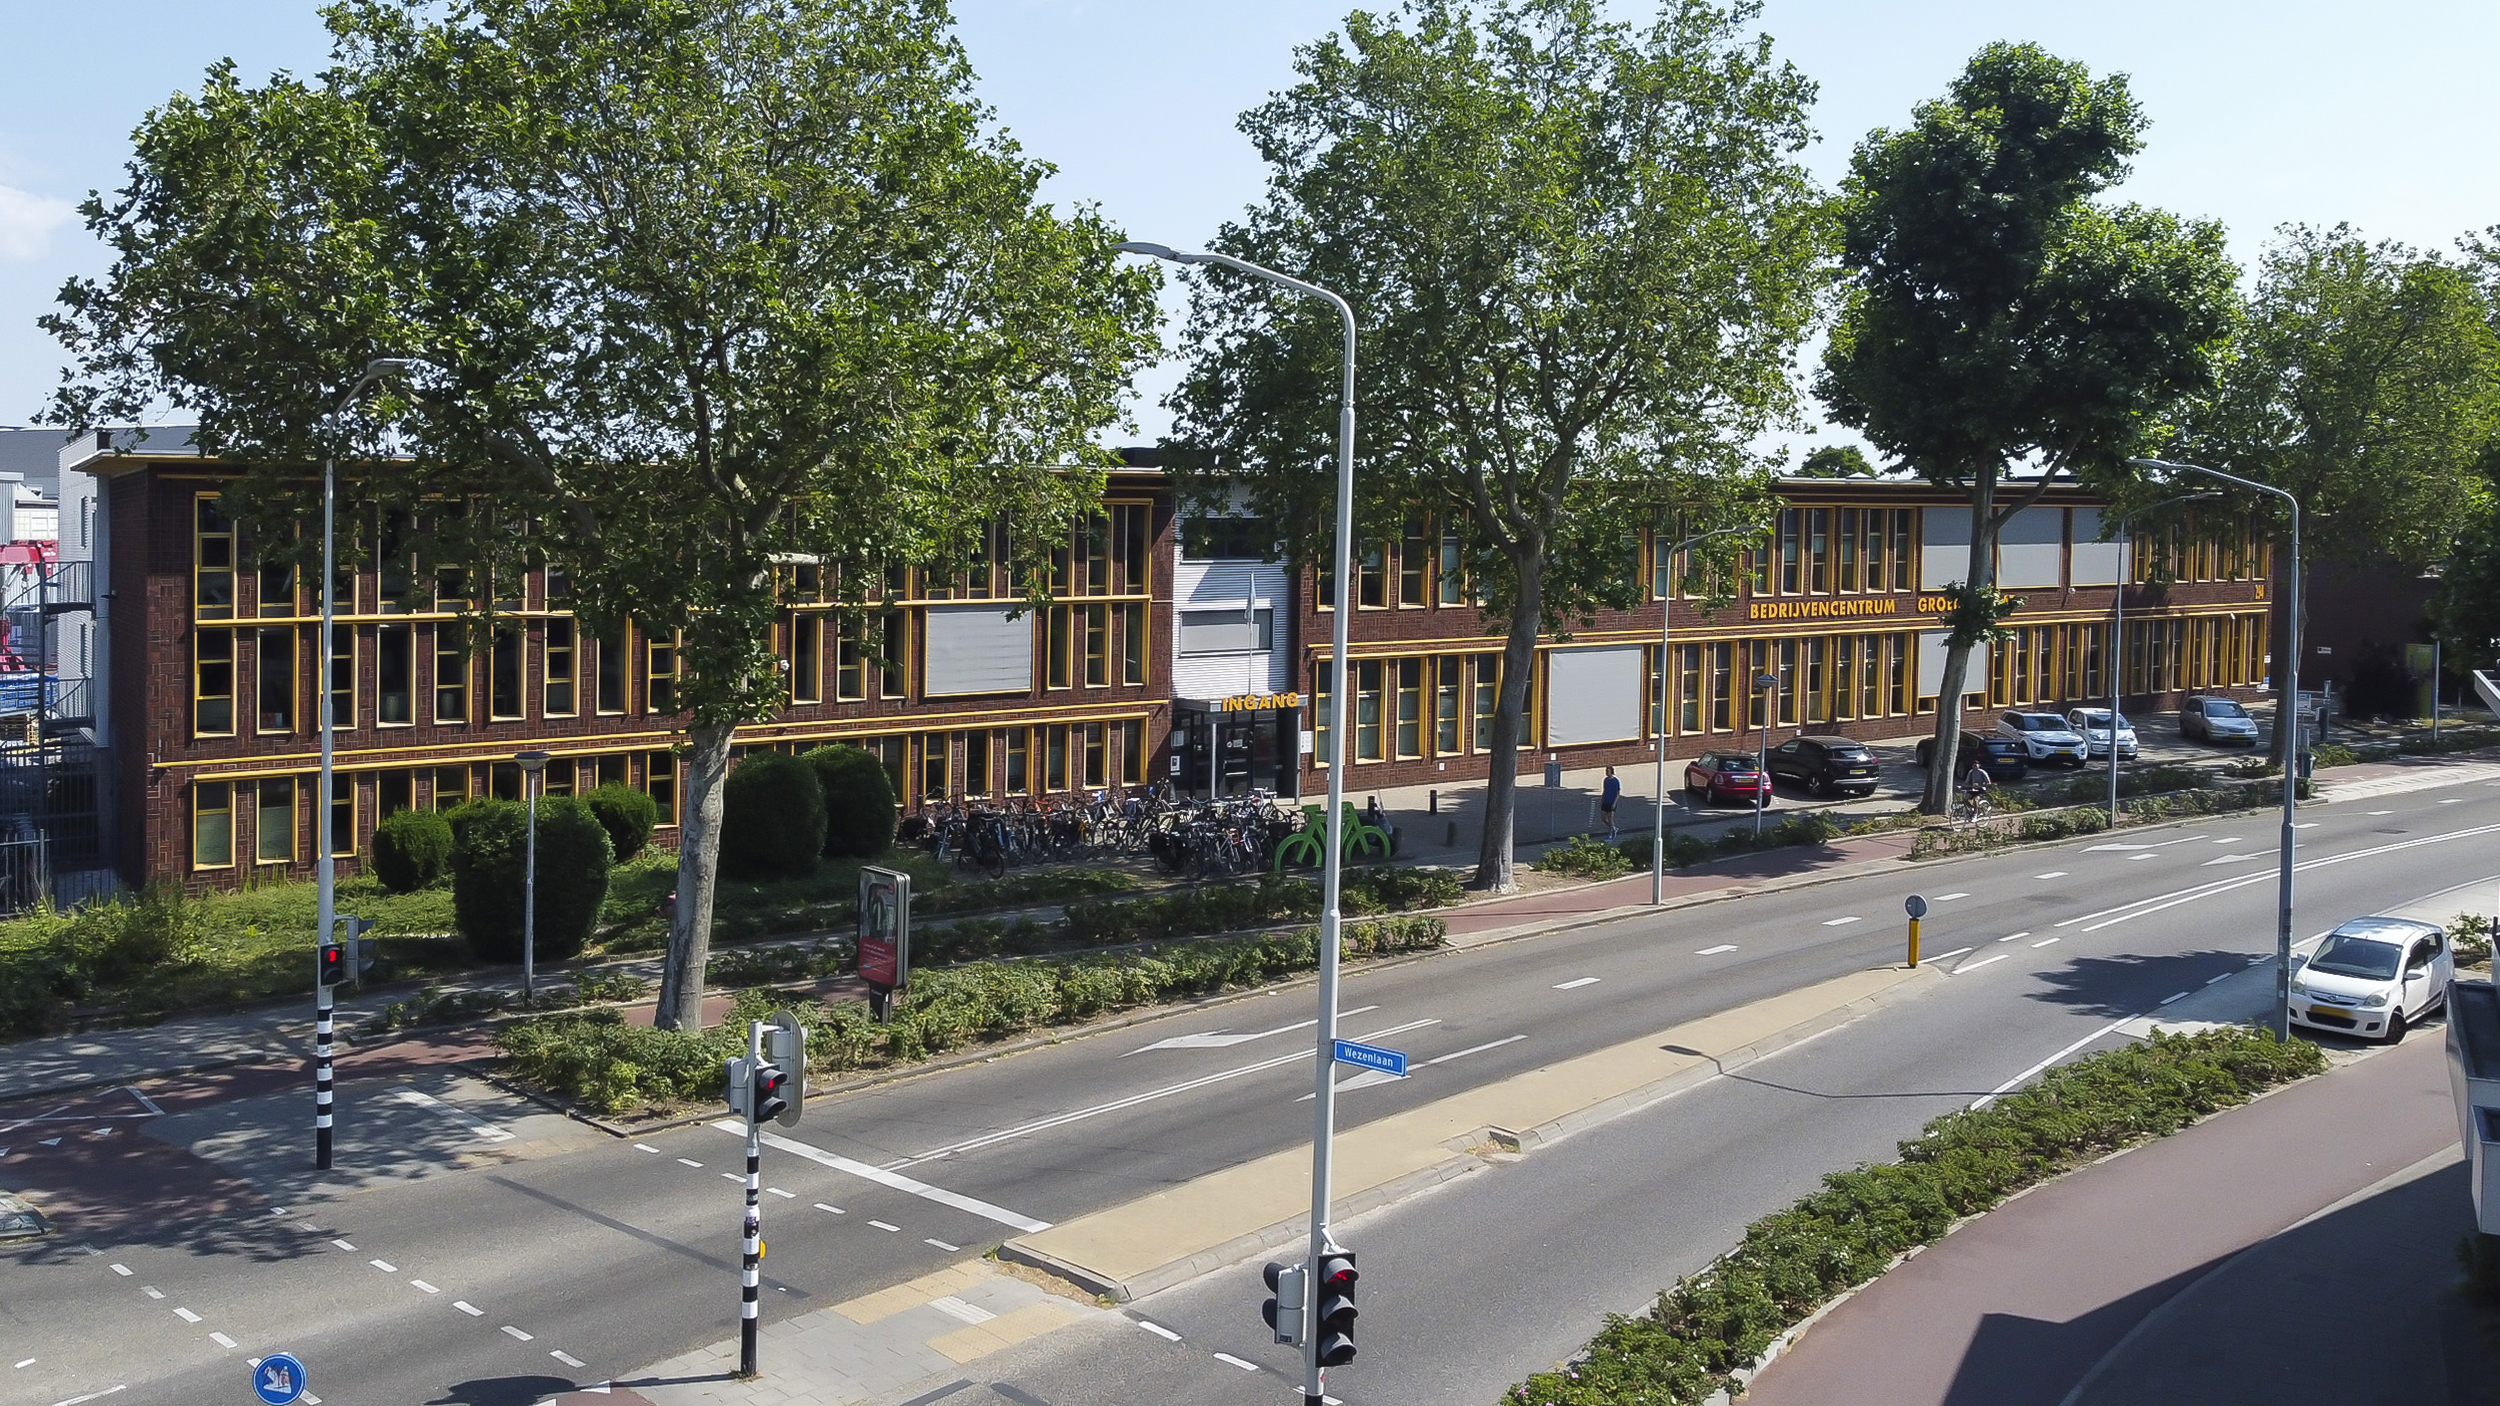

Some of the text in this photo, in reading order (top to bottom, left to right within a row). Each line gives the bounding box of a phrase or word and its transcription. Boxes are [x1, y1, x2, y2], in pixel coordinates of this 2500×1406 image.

[1750, 599, 1895, 619] BEDRIJVENCENTRUM
[1222, 692, 1299, 712] INGANG
[1344, 1047, 1393, 1067] Wezenlaan
